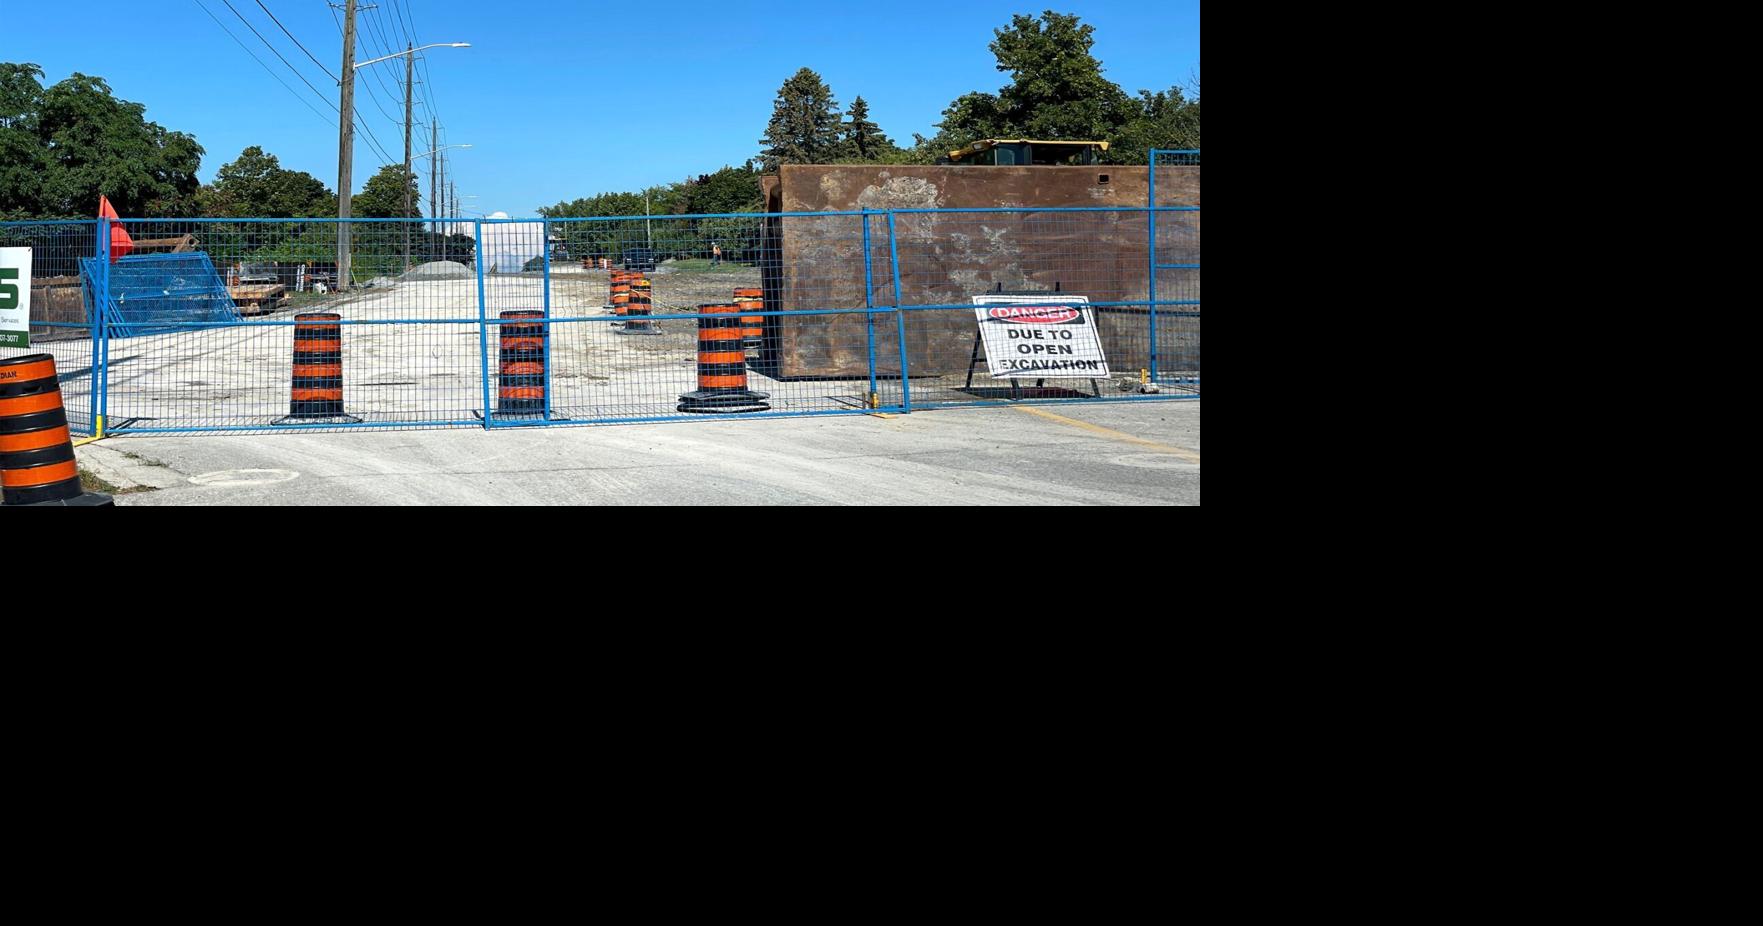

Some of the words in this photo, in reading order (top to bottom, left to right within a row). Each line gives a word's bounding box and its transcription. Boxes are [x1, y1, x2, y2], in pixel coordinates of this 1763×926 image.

[997, 306, 1071, 319] DANGER
[1008, 329, 1044, 340] DUE
[1048, 330, 1073, 340] TO
[1017, 344, 1073, 355] OPEN
[1000, 359, 1099, 370] EXCAVATION
